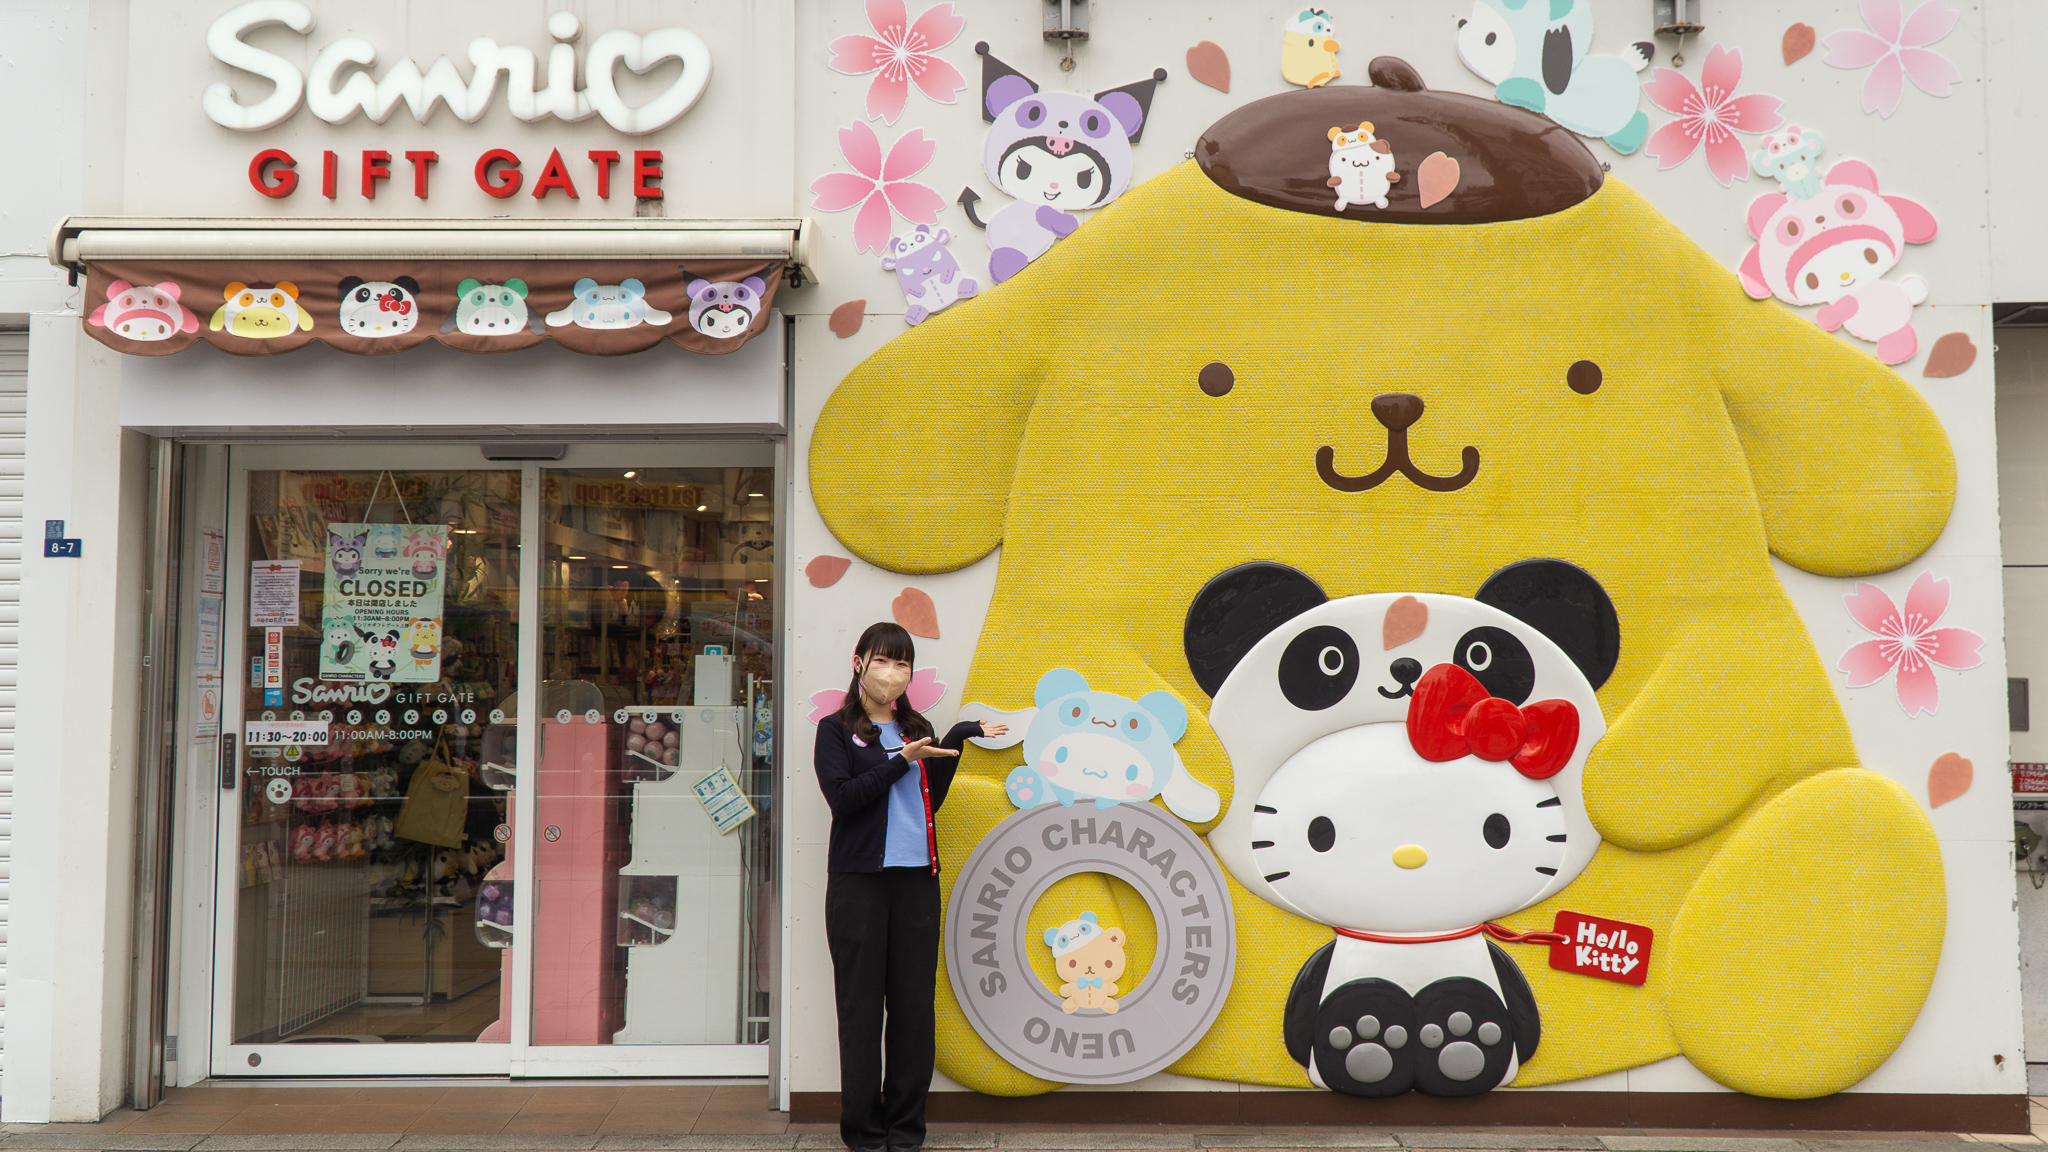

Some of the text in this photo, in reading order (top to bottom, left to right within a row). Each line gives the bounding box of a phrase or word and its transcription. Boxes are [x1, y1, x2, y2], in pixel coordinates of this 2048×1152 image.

[203, 0, 712, 135] Sanrio
[248, 147, 664, 200] GIFT GATE
[51, 542, 74, 553] 8-7
[358, 566, 411, 577] Sorry we're
[339, 579, 428, 598] CLOSED
[347, 599, 418, 608] 本日は閉店しました
[292, 678, 390, 704] Sanrio
[395, 693, 432, 704] GIFT
[437, 692, 474, 704] GATE
[334, 729, 433, 741] 11:00AM-8:00PM
[260, 766, 300, 776] TOUCH
[970, 818, 1212, 1006] SANRIO CHARACTERS
[1576, 921, 1639, 955] Hello
[1575, 945, 1640, 976] Kitty
[1023, 1017, 1136, 1060] UENO
